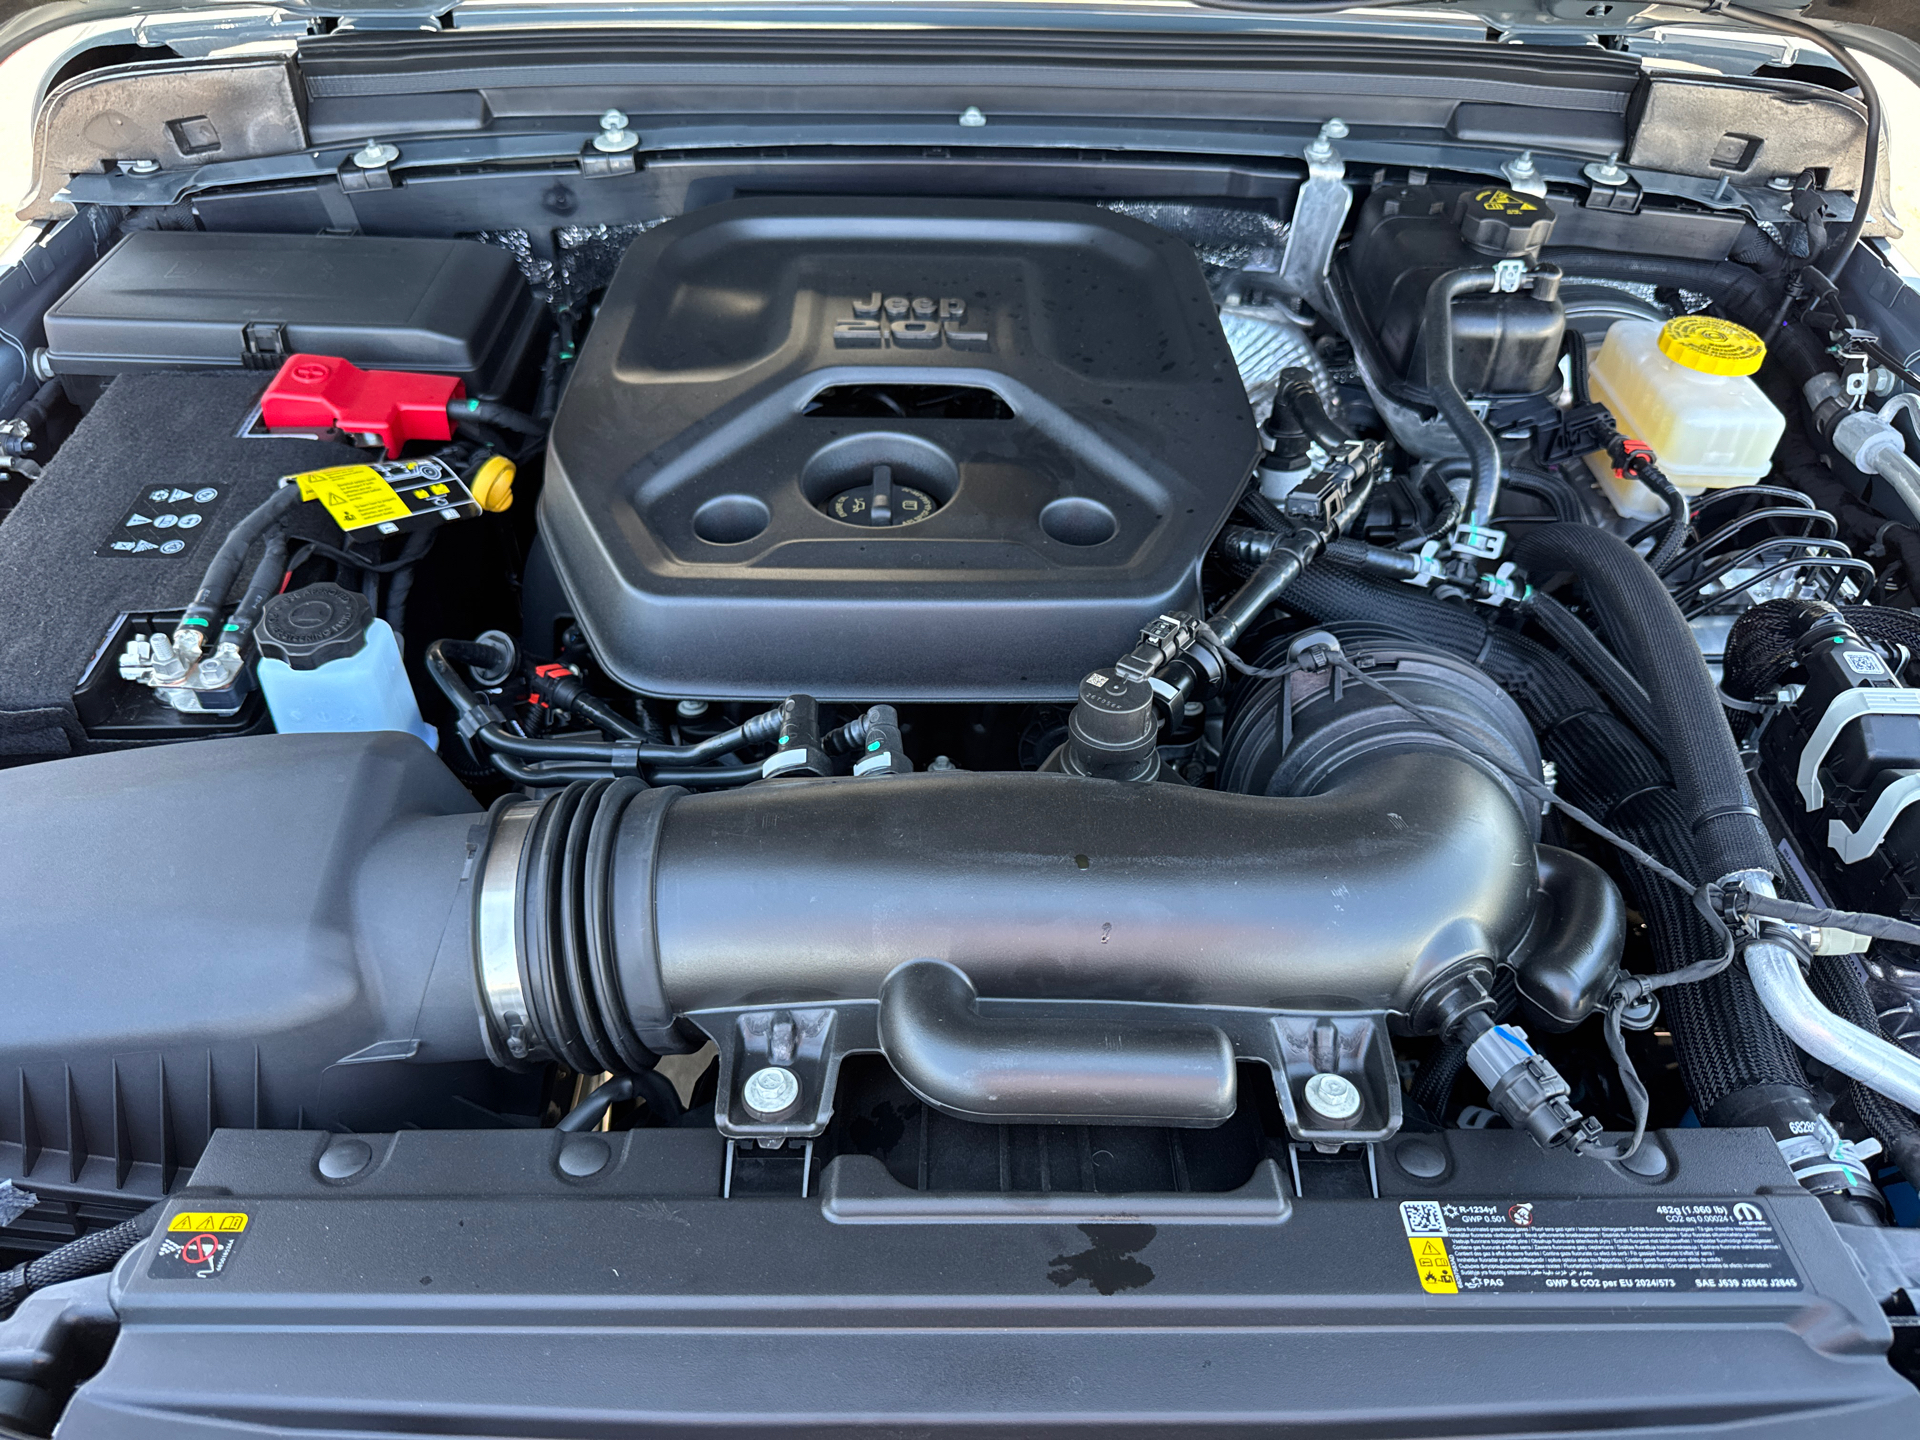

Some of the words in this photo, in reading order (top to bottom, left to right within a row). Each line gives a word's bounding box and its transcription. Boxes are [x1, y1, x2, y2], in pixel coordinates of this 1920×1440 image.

[853, 292, 966, 320] Jeep
[833, 319, 990, 344] 2.0L
[281, 591, 301, 605] USE
[303, 587, 350, 604] APPROVED
[1459, 1206, 1498, 1214] R-1234yf
[1656, 1205, 1681, 1215] 482g
[1461, 1215, 1483, 1223] GWP
[1484, 1215, 1507, 1223] 0.501
[1665, 1215, 1684, 1223] CO2
[1483, 1278, 1504, 1287] PAG
[1545, 1279, 1569, 1288] GWP
[1570, 1279, 1579, 1288] &
[1580, 1279, 1601, 1288] CO2
[1602, 1280, 1618, 1289] per
[1619, 1278, 1634, 1288] EU
[1694, 1278, 1716, 1288] SAE
[1718, 1278, 1740, 1288] J639
[1742, 1278, 1769, 1288] J2842
[1769, 1278, 1798, 1288] J2845
